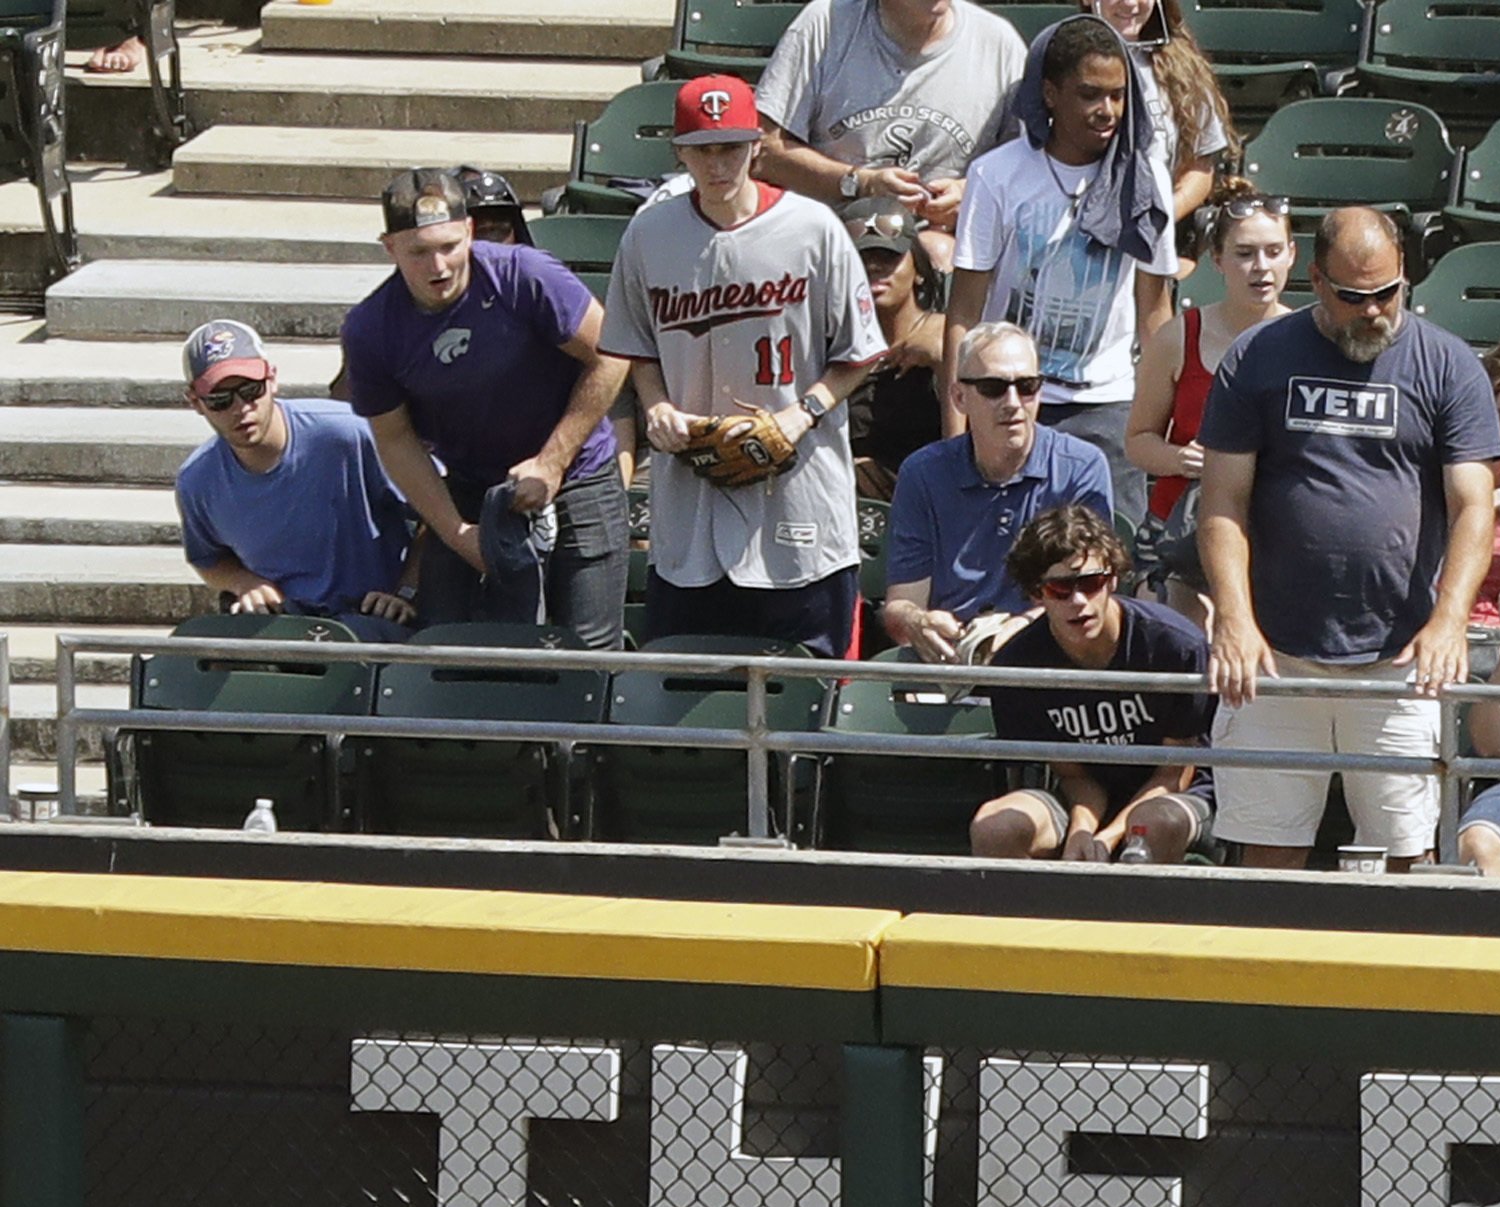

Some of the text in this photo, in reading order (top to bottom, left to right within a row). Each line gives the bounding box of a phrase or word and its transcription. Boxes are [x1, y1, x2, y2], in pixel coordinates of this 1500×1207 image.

[842, 105, 975, 156] WORLD SERIES
[649, 272, 809, 328] Minnesota
[754, 334, 795, 386] 11
[1298, 385, 1387, 419] YETI
[1046, 701, 1118, 737] POLO
